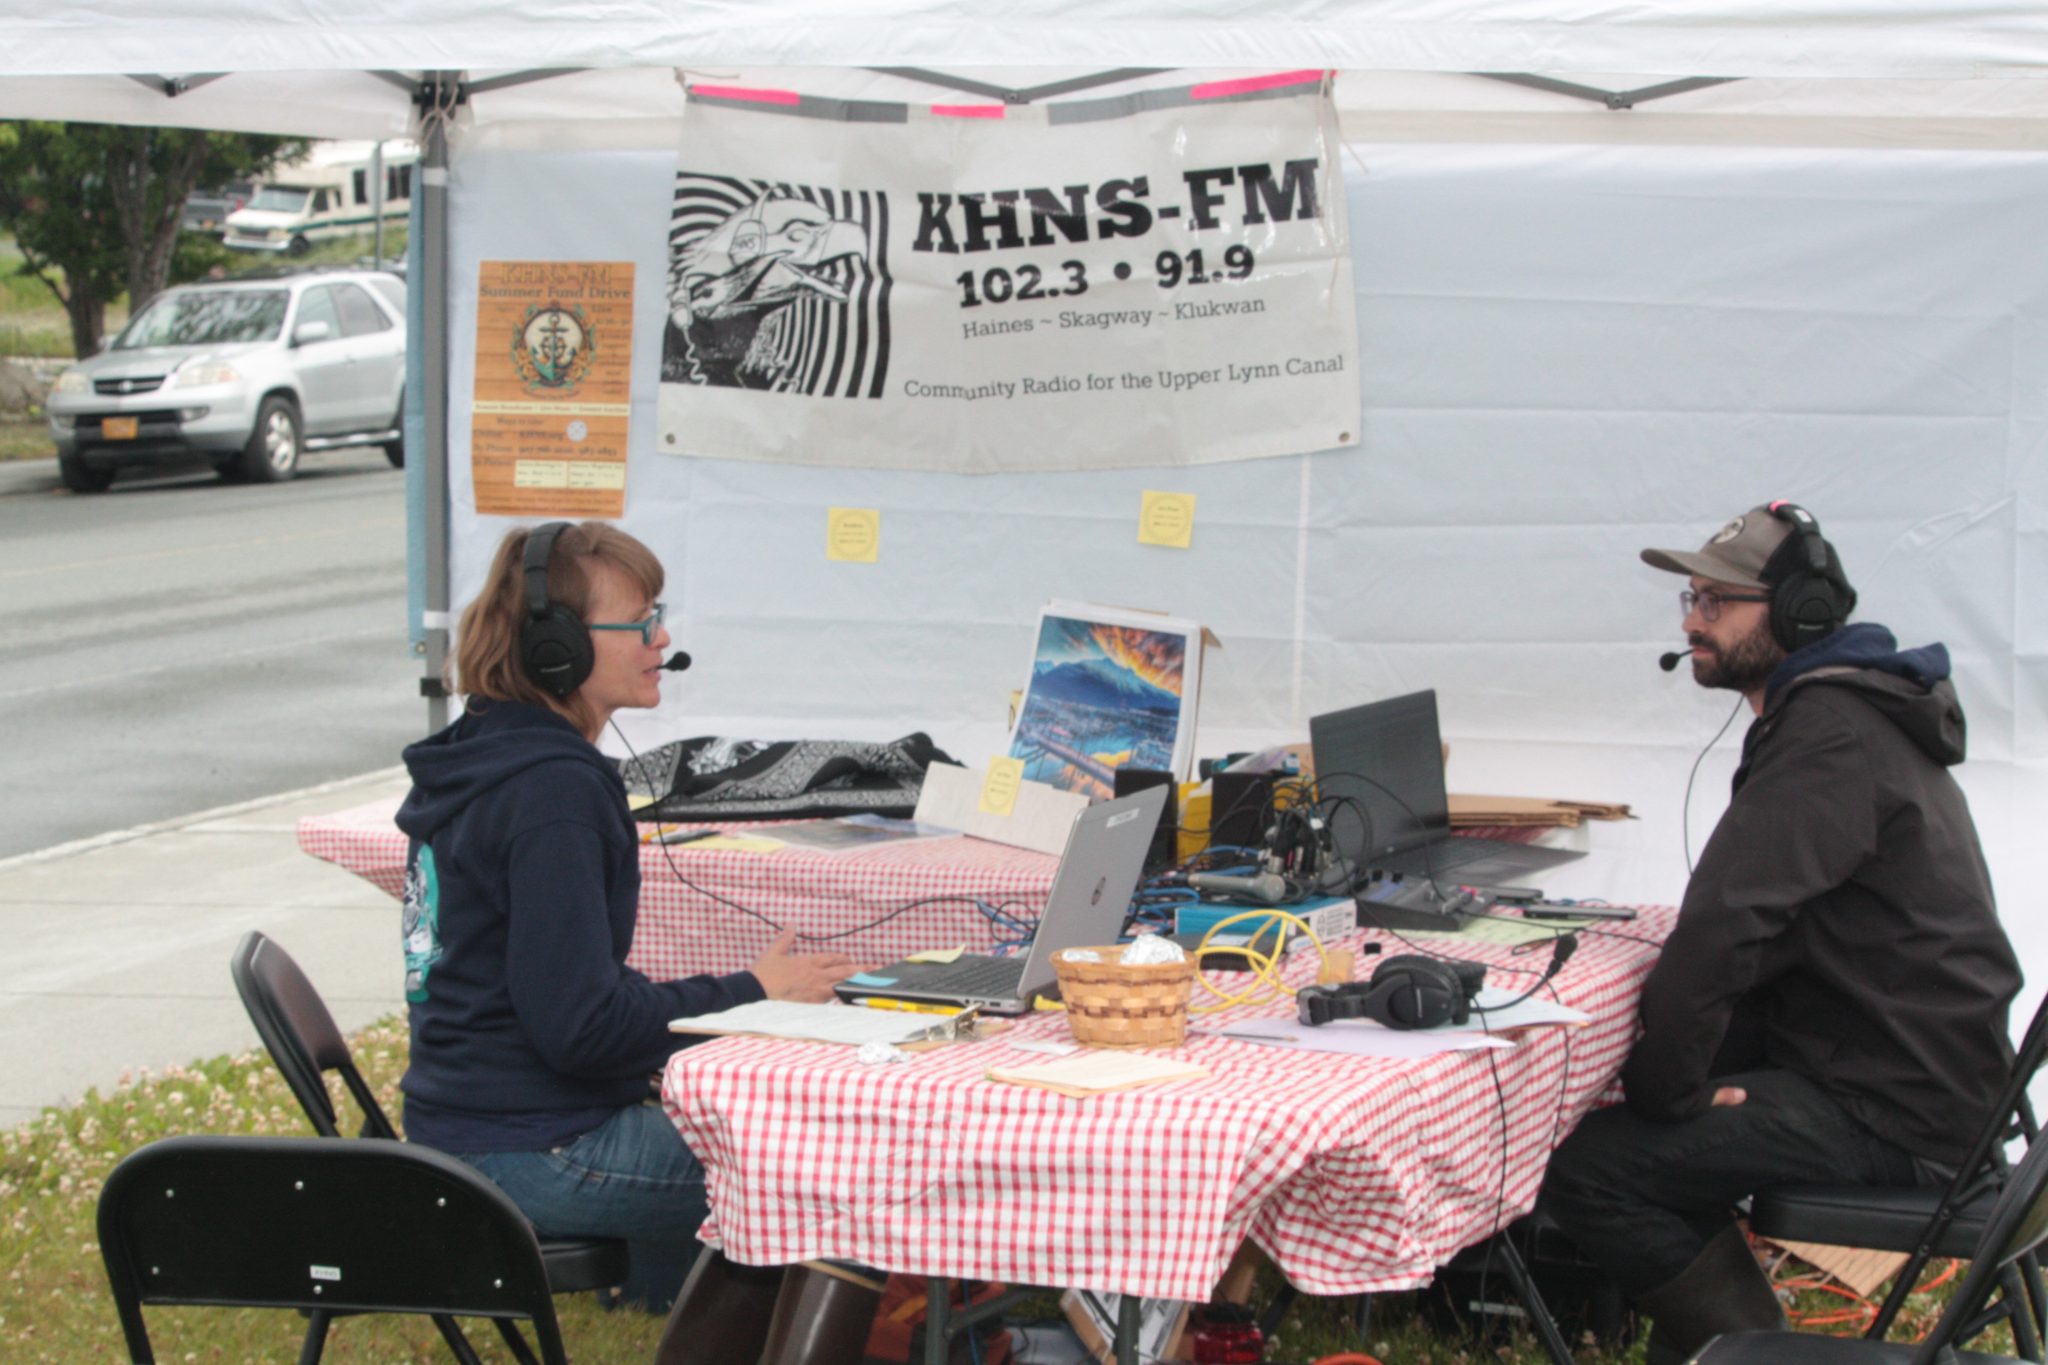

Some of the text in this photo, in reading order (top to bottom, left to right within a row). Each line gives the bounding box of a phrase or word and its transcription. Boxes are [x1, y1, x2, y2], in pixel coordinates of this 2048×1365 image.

[912, 158, 1320, 255] KHNS-FM
[480, 285, 632, 299] Summer Fund Drive
[956, 243, 1256, 309] 102.3 91.9
[962, 318, 1034, 339] Haines
[1059, 310, 1152, 330] Skagway
[1175, 299, 1266, 320] Klukwan
[904, 354, 1344, 400] Community Radio for the Upper Lynn Canal
